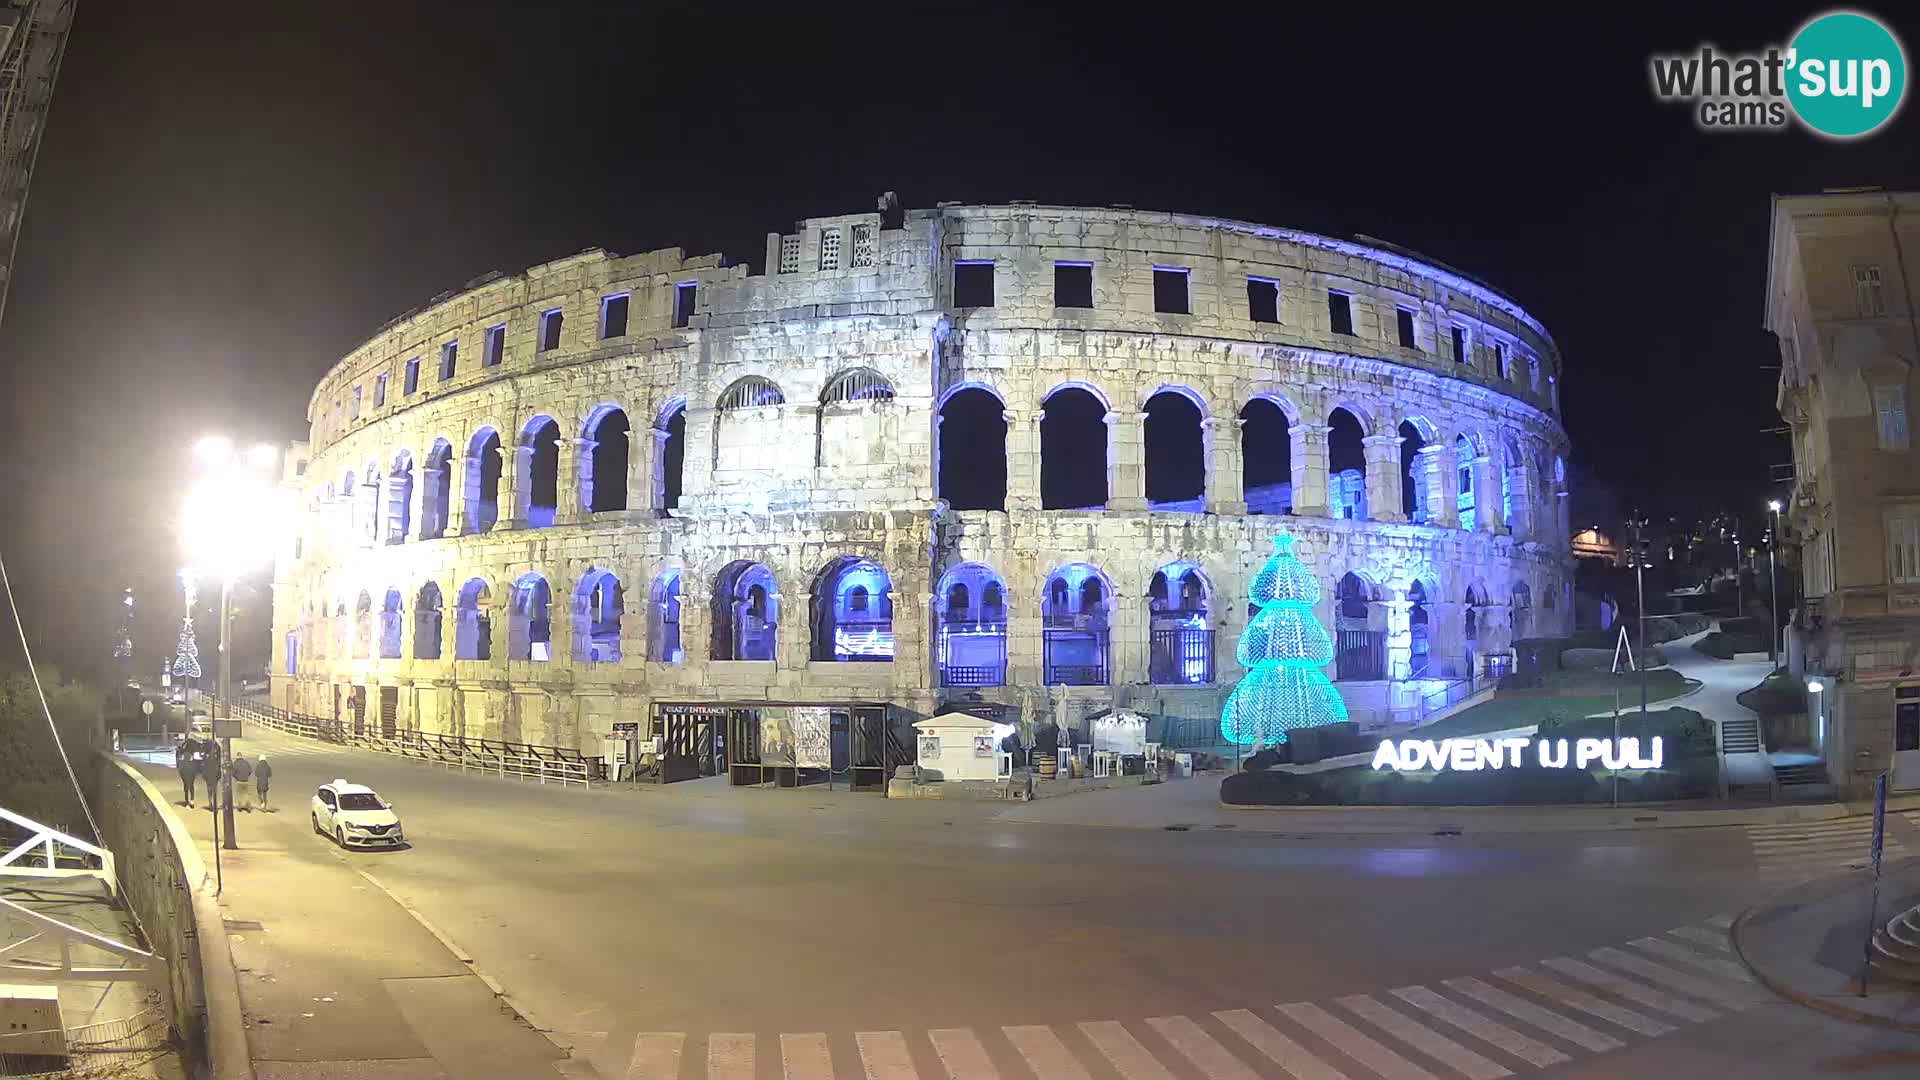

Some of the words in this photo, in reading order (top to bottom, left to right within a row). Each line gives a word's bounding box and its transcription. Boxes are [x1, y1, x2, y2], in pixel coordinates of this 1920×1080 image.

[689, 706, 725, 714] ENTRANCE
[1372, 737, 1530, 771] ADVENT
[1538, 737, 1569, 769] U
[1576, 736, 1663, 770] PULI
